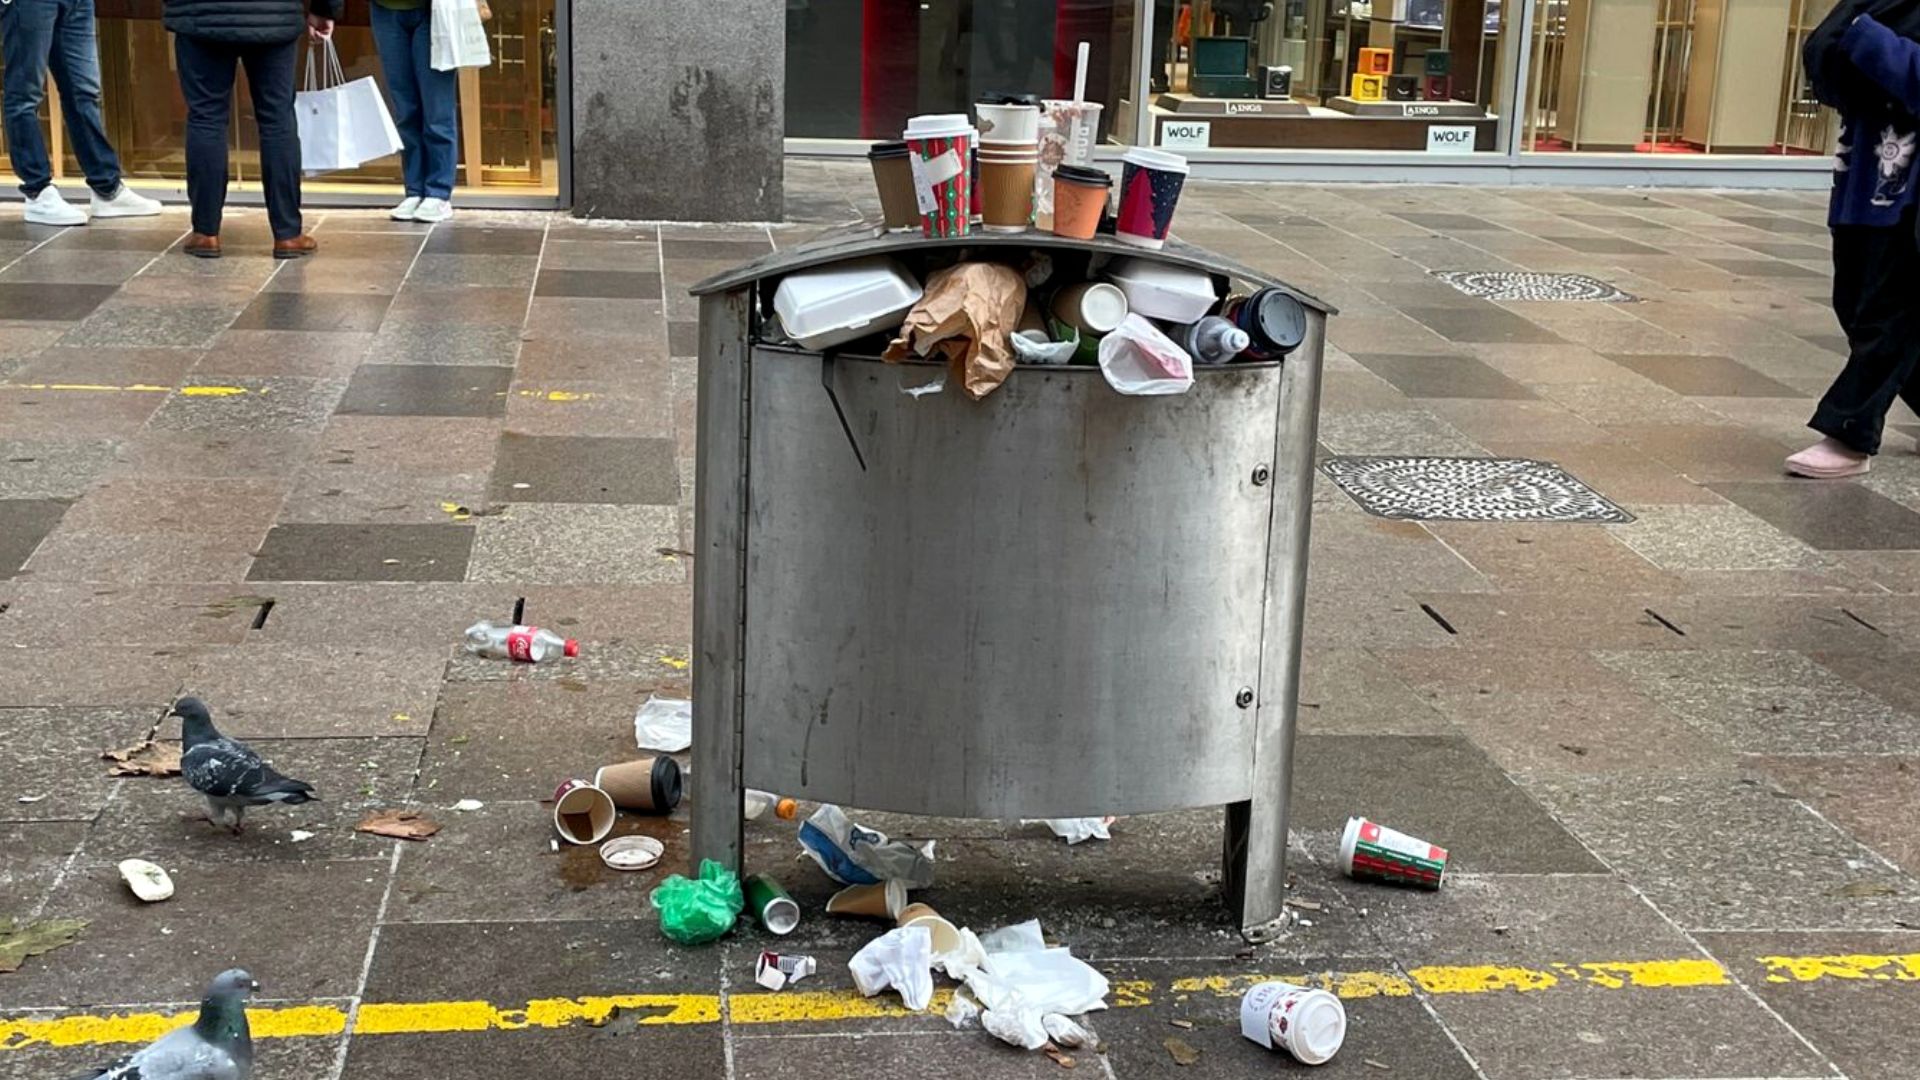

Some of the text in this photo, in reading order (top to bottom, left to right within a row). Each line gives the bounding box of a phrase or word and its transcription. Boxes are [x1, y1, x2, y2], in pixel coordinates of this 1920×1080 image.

[1225, 101, 1262, 114] LAINGS
[1403, 103, 1439, 116] LAINGS
[1167, 126, 1205, 138] WOLF
[1433, 131, 1471, 142] WOLF
